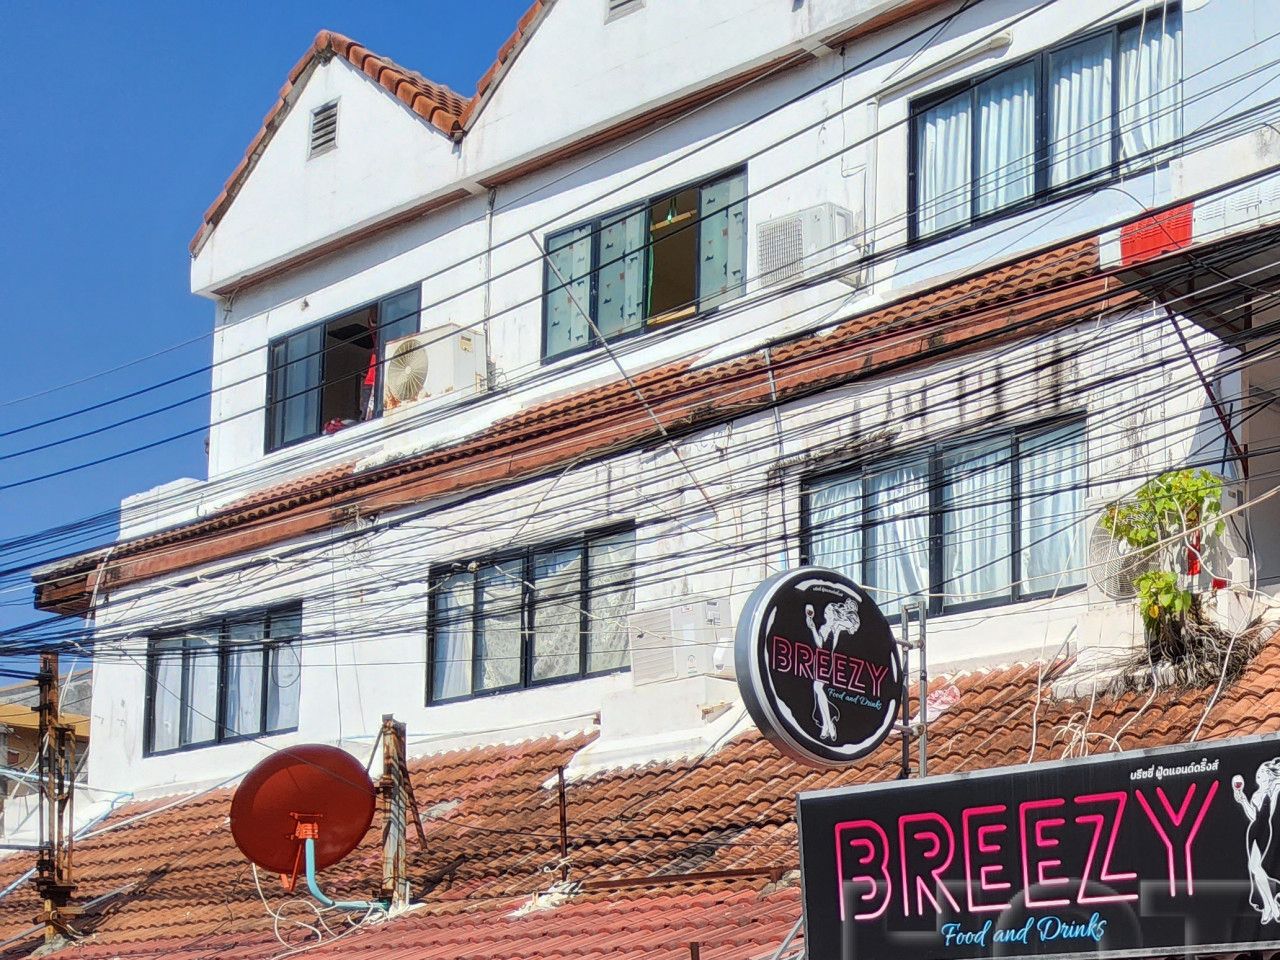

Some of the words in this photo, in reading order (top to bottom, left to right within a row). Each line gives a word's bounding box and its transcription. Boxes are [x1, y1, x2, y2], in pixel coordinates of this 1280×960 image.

[771, 635, 889, 697] BREEZY
[827, 687, 846, 700] Food
[846, 694, 860, 704] and
[860, 695, 882, 710] Drinks
[834, 779, 1219, 921] BREEZY
[941, 919, 993, 946] Food
[993, 917, 1034, 945] and
[1037, 912, 1107, 942] Drinks
